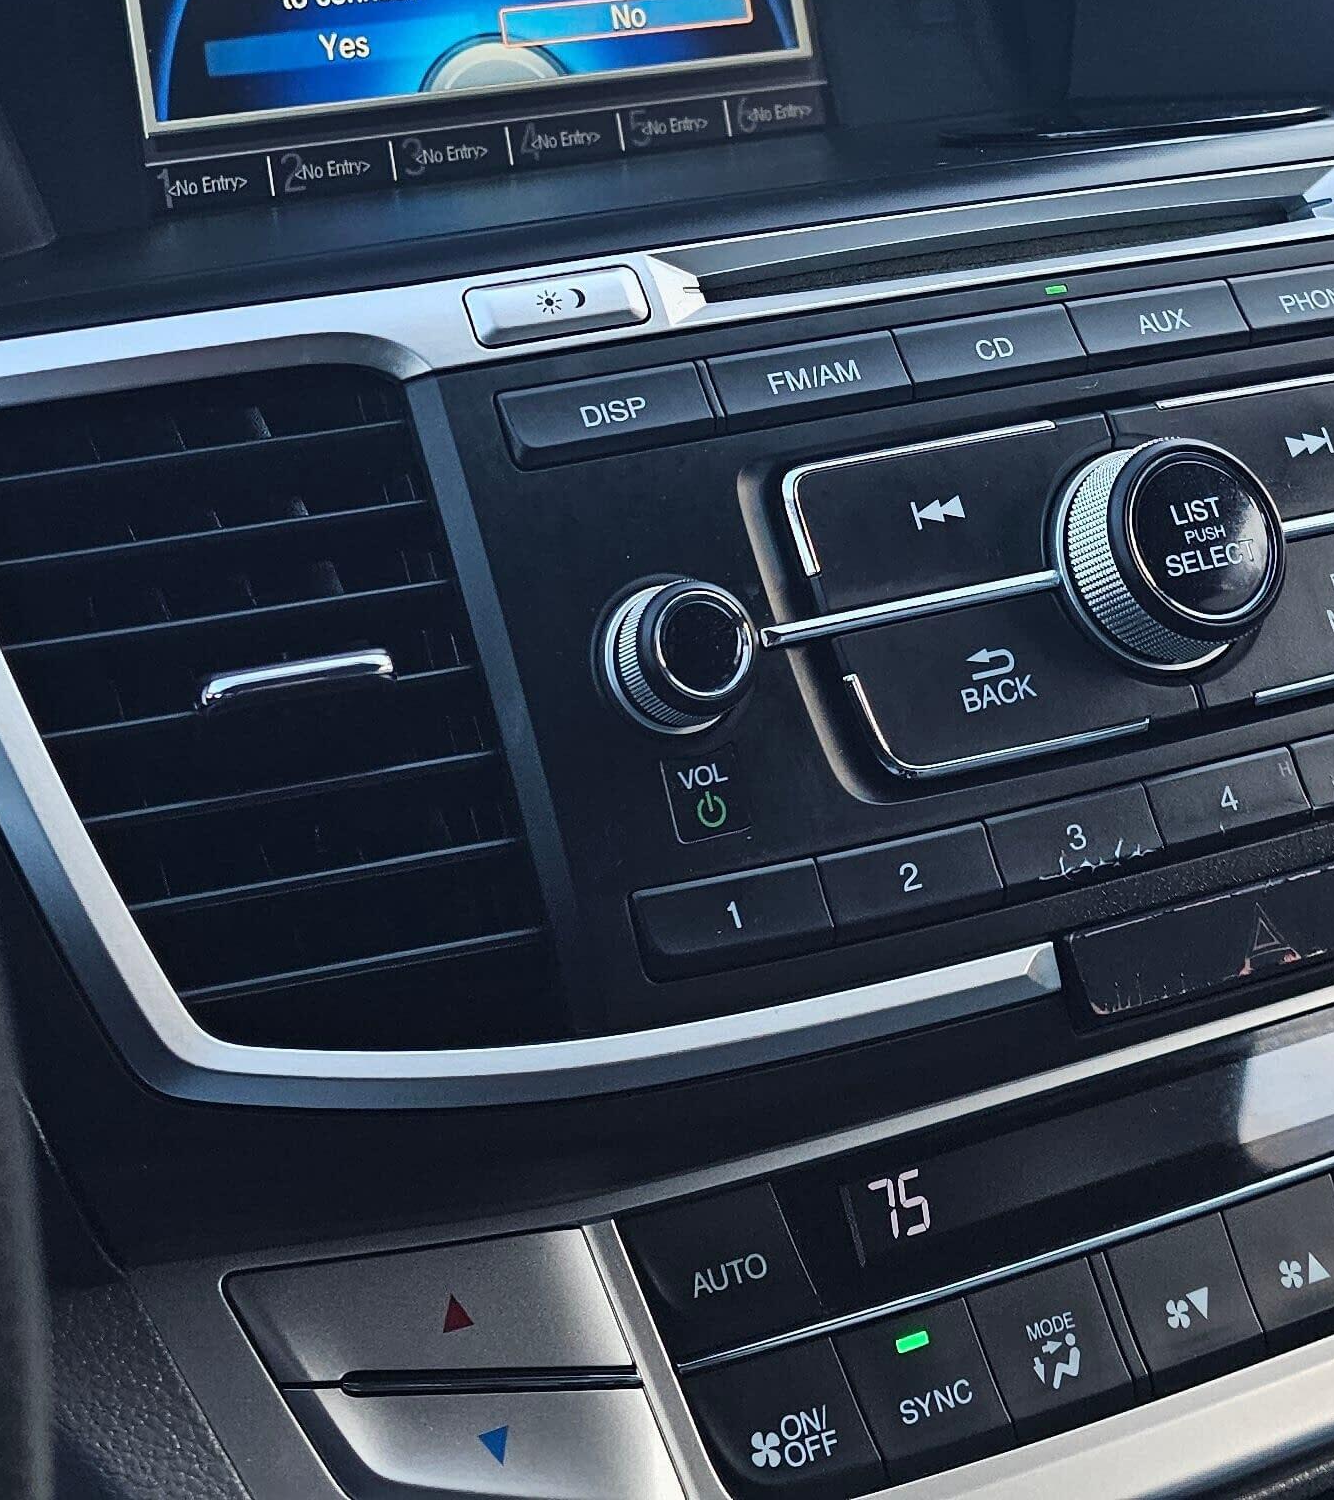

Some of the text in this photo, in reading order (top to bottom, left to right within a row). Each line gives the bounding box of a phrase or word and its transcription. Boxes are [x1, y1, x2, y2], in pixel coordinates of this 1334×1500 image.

[609, 3, 648, 31] No
[317, 31, 372, 62] Yes
[416, 149, 444, 165] <No
[447, 145, 488, 163] Entry>
[295, 164, 324, 181] <No
[328, 161, 371, 179] Entry>
[168, 178, 199, 198] <No
[202, 176, 248, 196] Entry>
[1139, 308, 1193, 335] AUX
[975, 337, 1014, 361] CD
[766, 359, 862, 395] FM/AM
[579, 396, 646, 428] DISP
[1169, 496, 1221, 524] LIST
[1184, 525, 1226, 544] PUSH
[1165, 540, 1255, 577] SELECT
[960, 675, 1038, 713] BACK
[677, 762, 729, 790] VOL
[1220, 785, 1239, 811] 4
[1064, 822, 1087, 851] 3
[899, 862, 923, 893] 2
[726, 900, 742, 929] 1
[867, 1168, 931, 1240] 75
[693, 1253, 768, 1299] AUTO
[1025, 1311, 1076, 1342] MODE
[899, 1378, 973, 1425] SYNC
[779, 1405, 829, 1438] ON/
[782, 1428, 840, 1470] OFF
